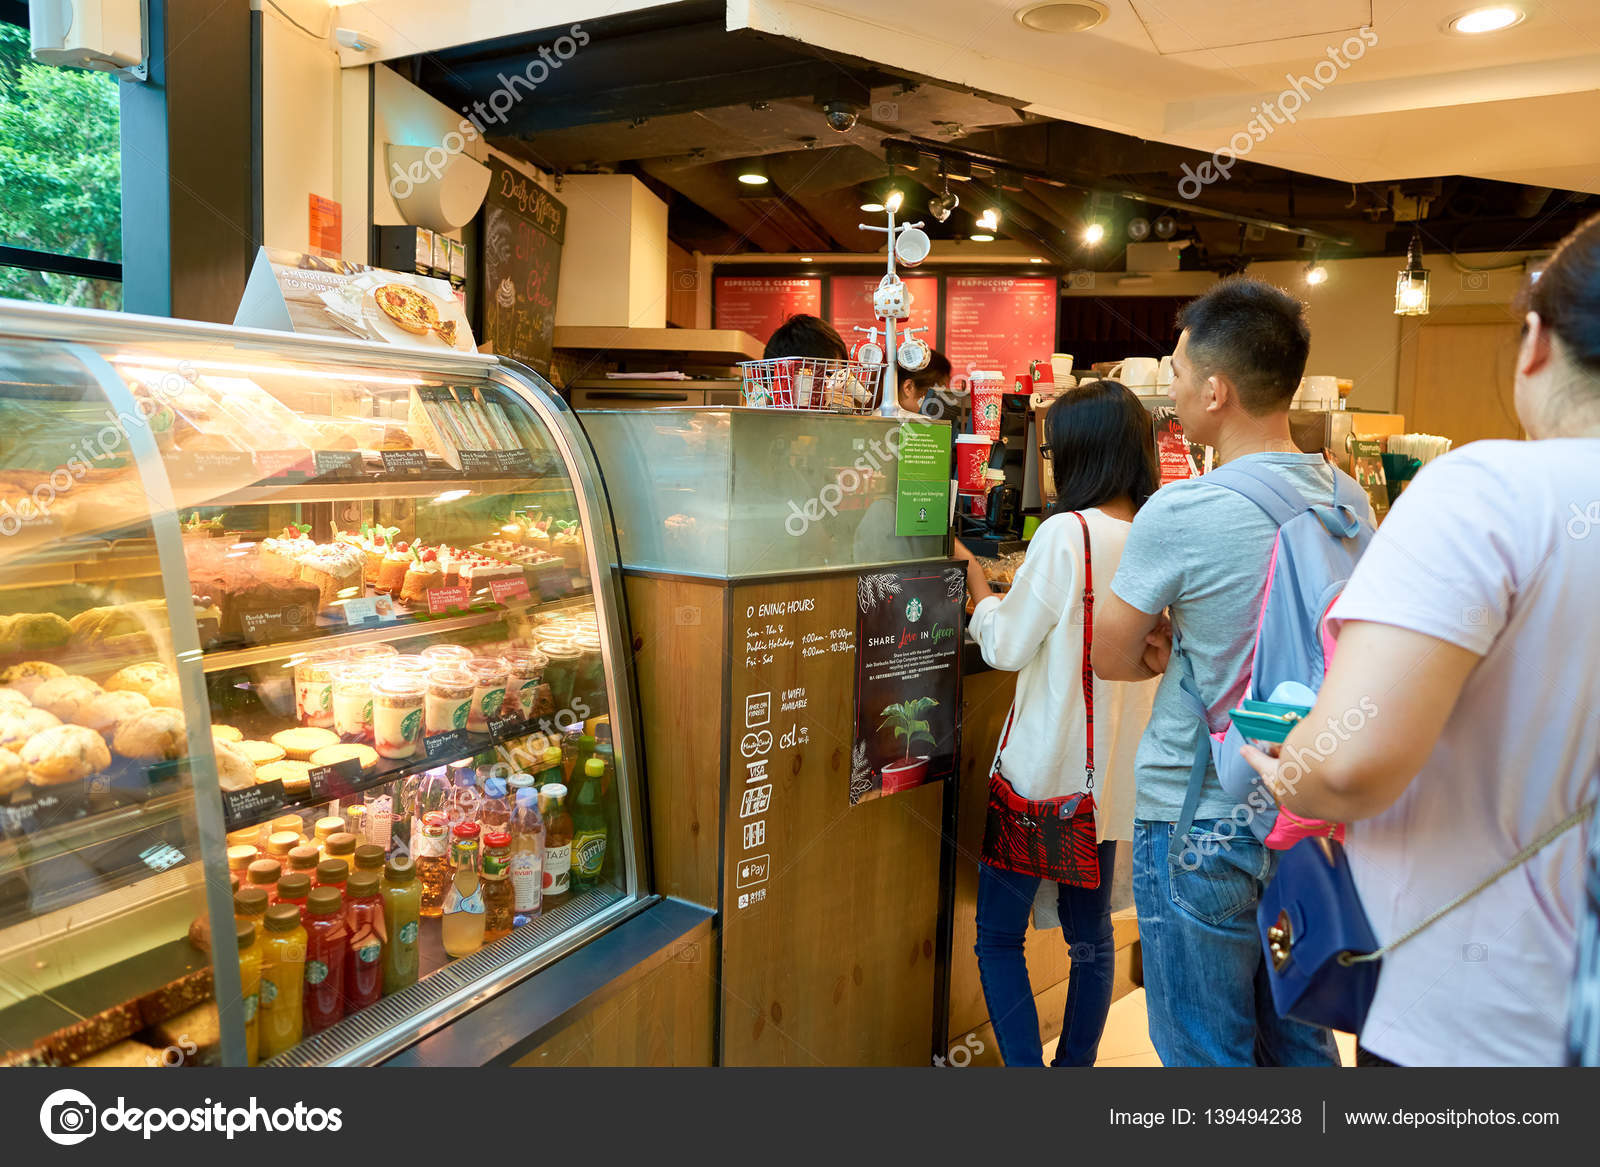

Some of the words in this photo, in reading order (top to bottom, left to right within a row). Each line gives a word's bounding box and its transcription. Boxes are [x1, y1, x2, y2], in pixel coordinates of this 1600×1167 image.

[787, 598, 815, 615] HOURS
[746, 626, 759, 639] Sun
[766, 624, 777, 635] Thu
[868, 635, 895, 647] SHARE
[898, 627, 917, 648] Love
[920, 631, 929, 640] IN
[931, 622, 954, 646] Green
[746, 640, 767, 654] Public
[768, 637, 795, 650] Holiday
[781, 698, 808, 713] AVAILABLE
[779, 723, 797, 749] csl
[750, 765, 765, 778] VISA
[547, 848, 570, 860] TAZO
[513, 869, 532, 877] evian
[751, 863, 766, 877] Pay
